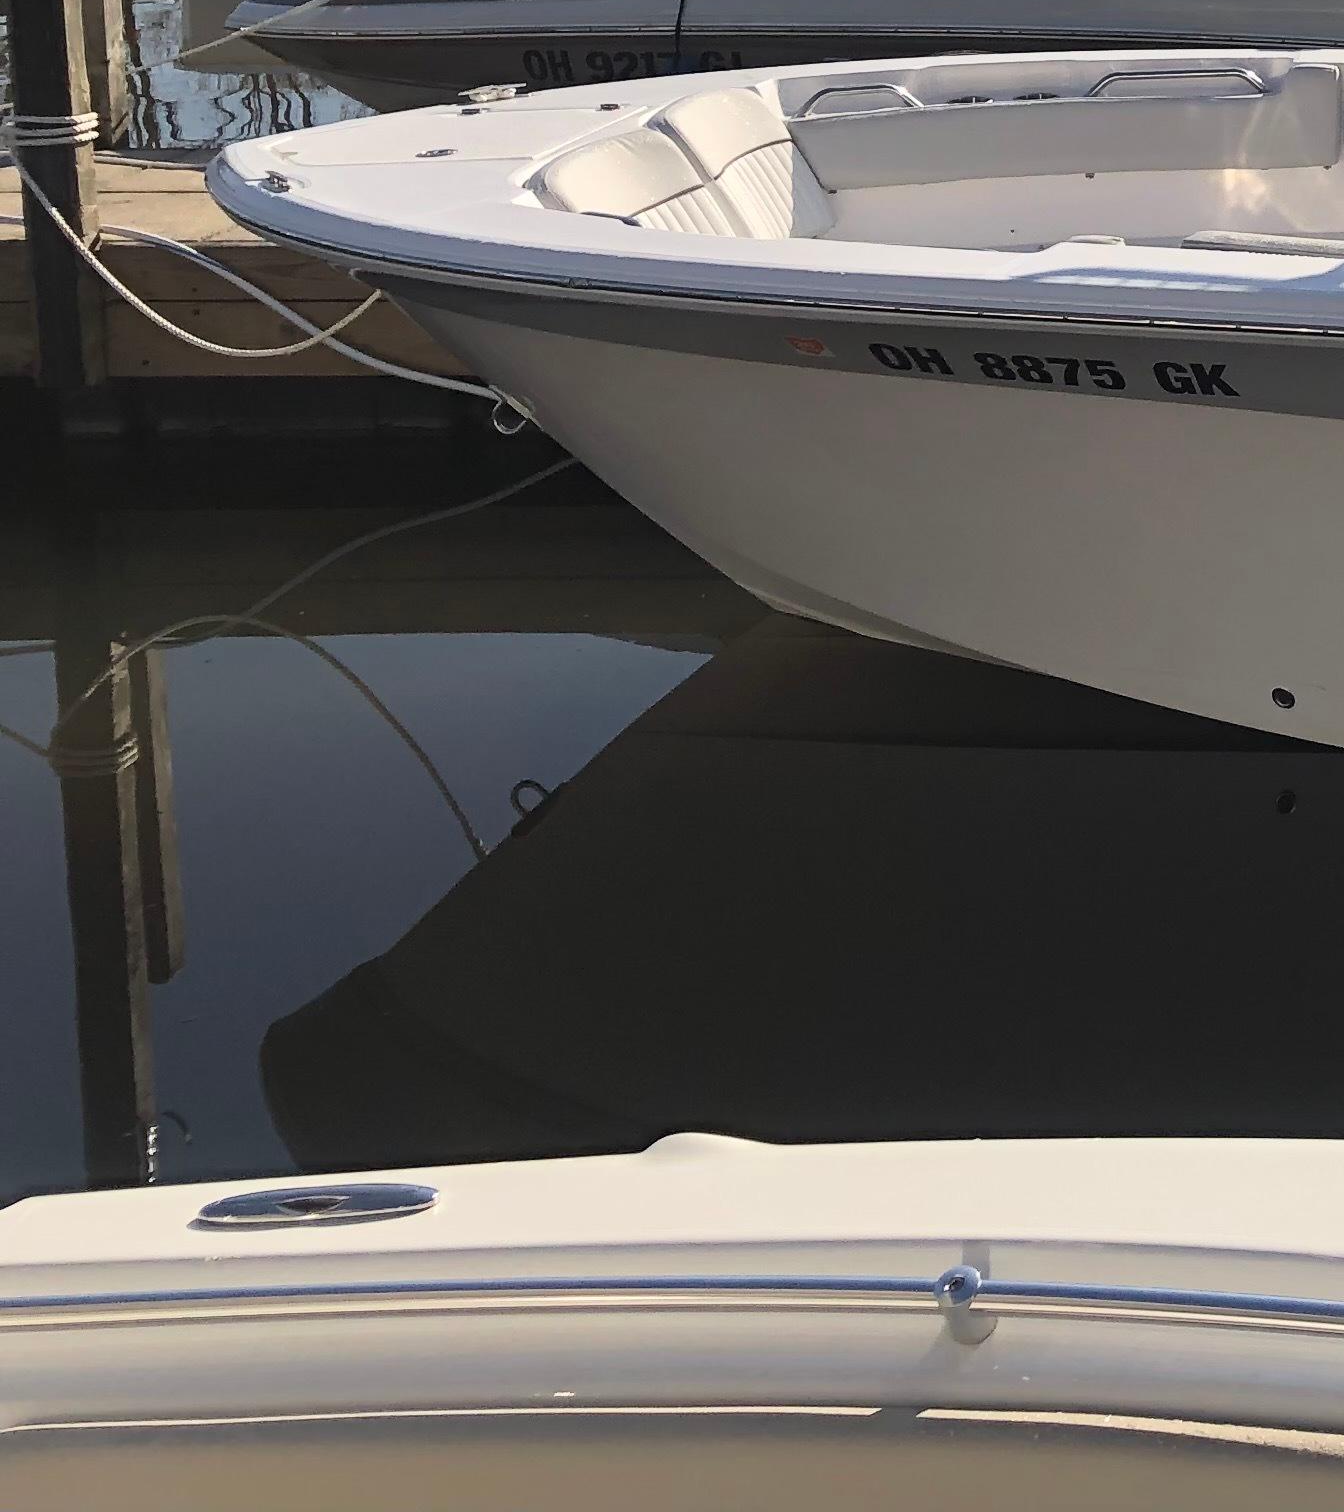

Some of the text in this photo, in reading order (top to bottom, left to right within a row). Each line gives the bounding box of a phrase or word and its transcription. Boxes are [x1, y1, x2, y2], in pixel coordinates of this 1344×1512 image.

[523, 50, 573, 81] OH
[868, 342, 1241, 397] OH 8875 GK
